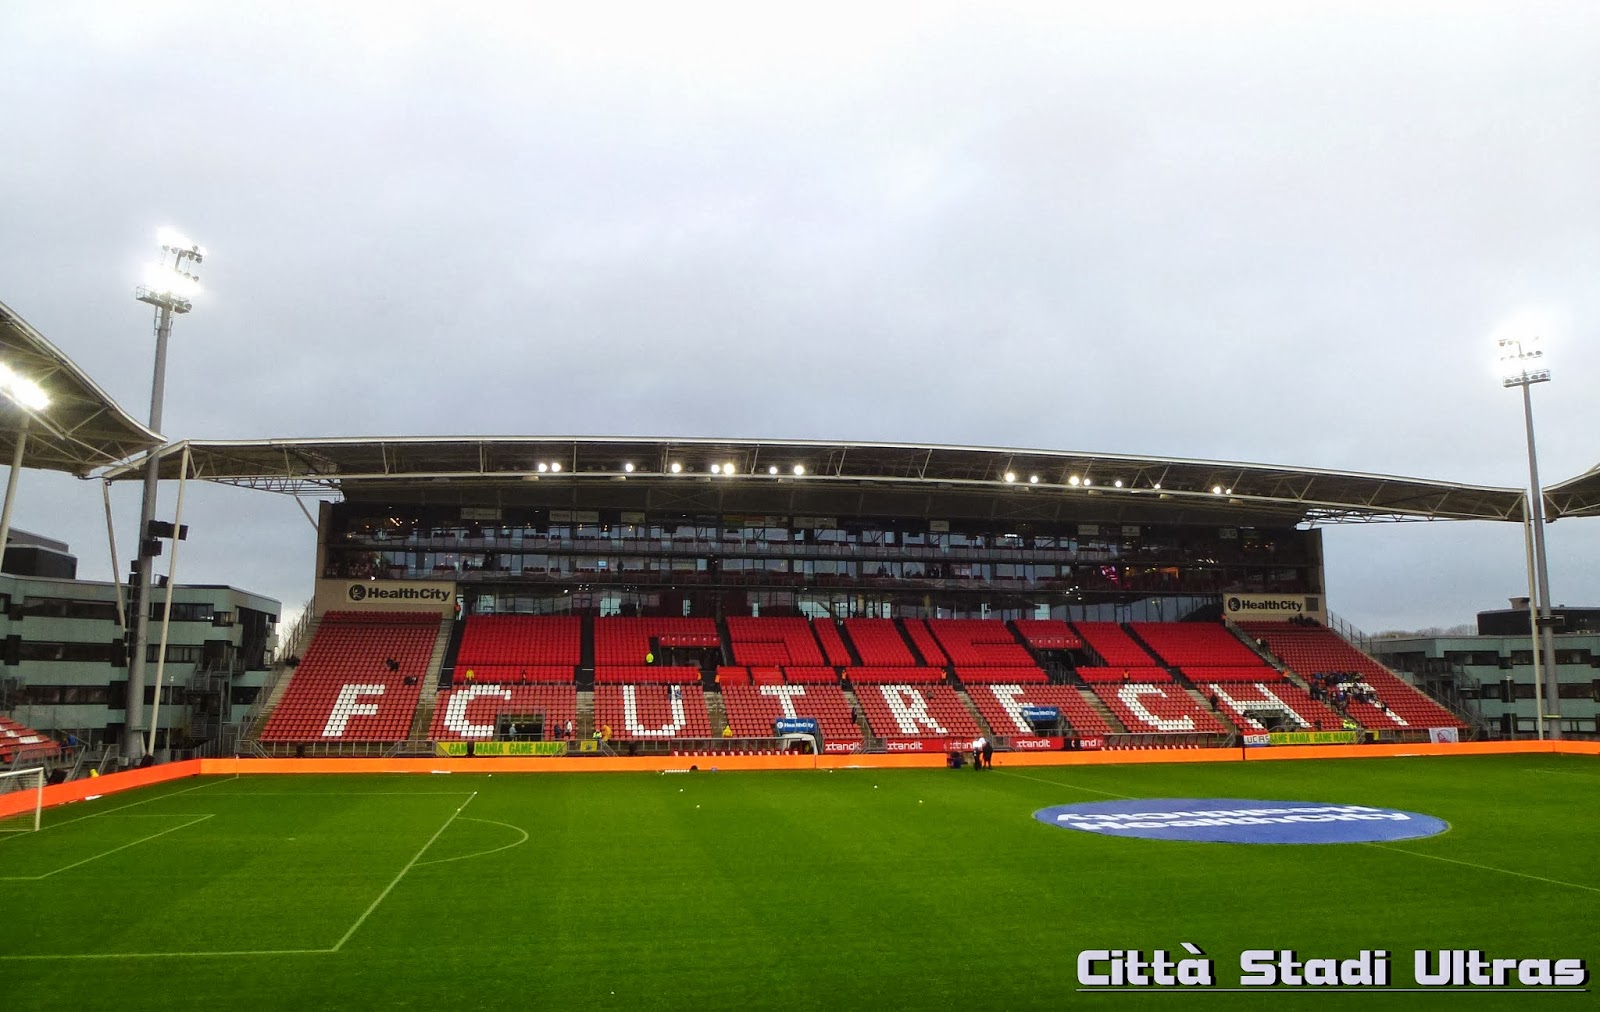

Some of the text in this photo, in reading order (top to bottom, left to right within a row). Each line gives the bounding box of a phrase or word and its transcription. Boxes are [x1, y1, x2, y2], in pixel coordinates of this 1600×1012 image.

[368, 587, 451, 602] HealthCity
[1242, 600, 1304, 612] HealthCity
[508, 742, 534, 754] GAME
